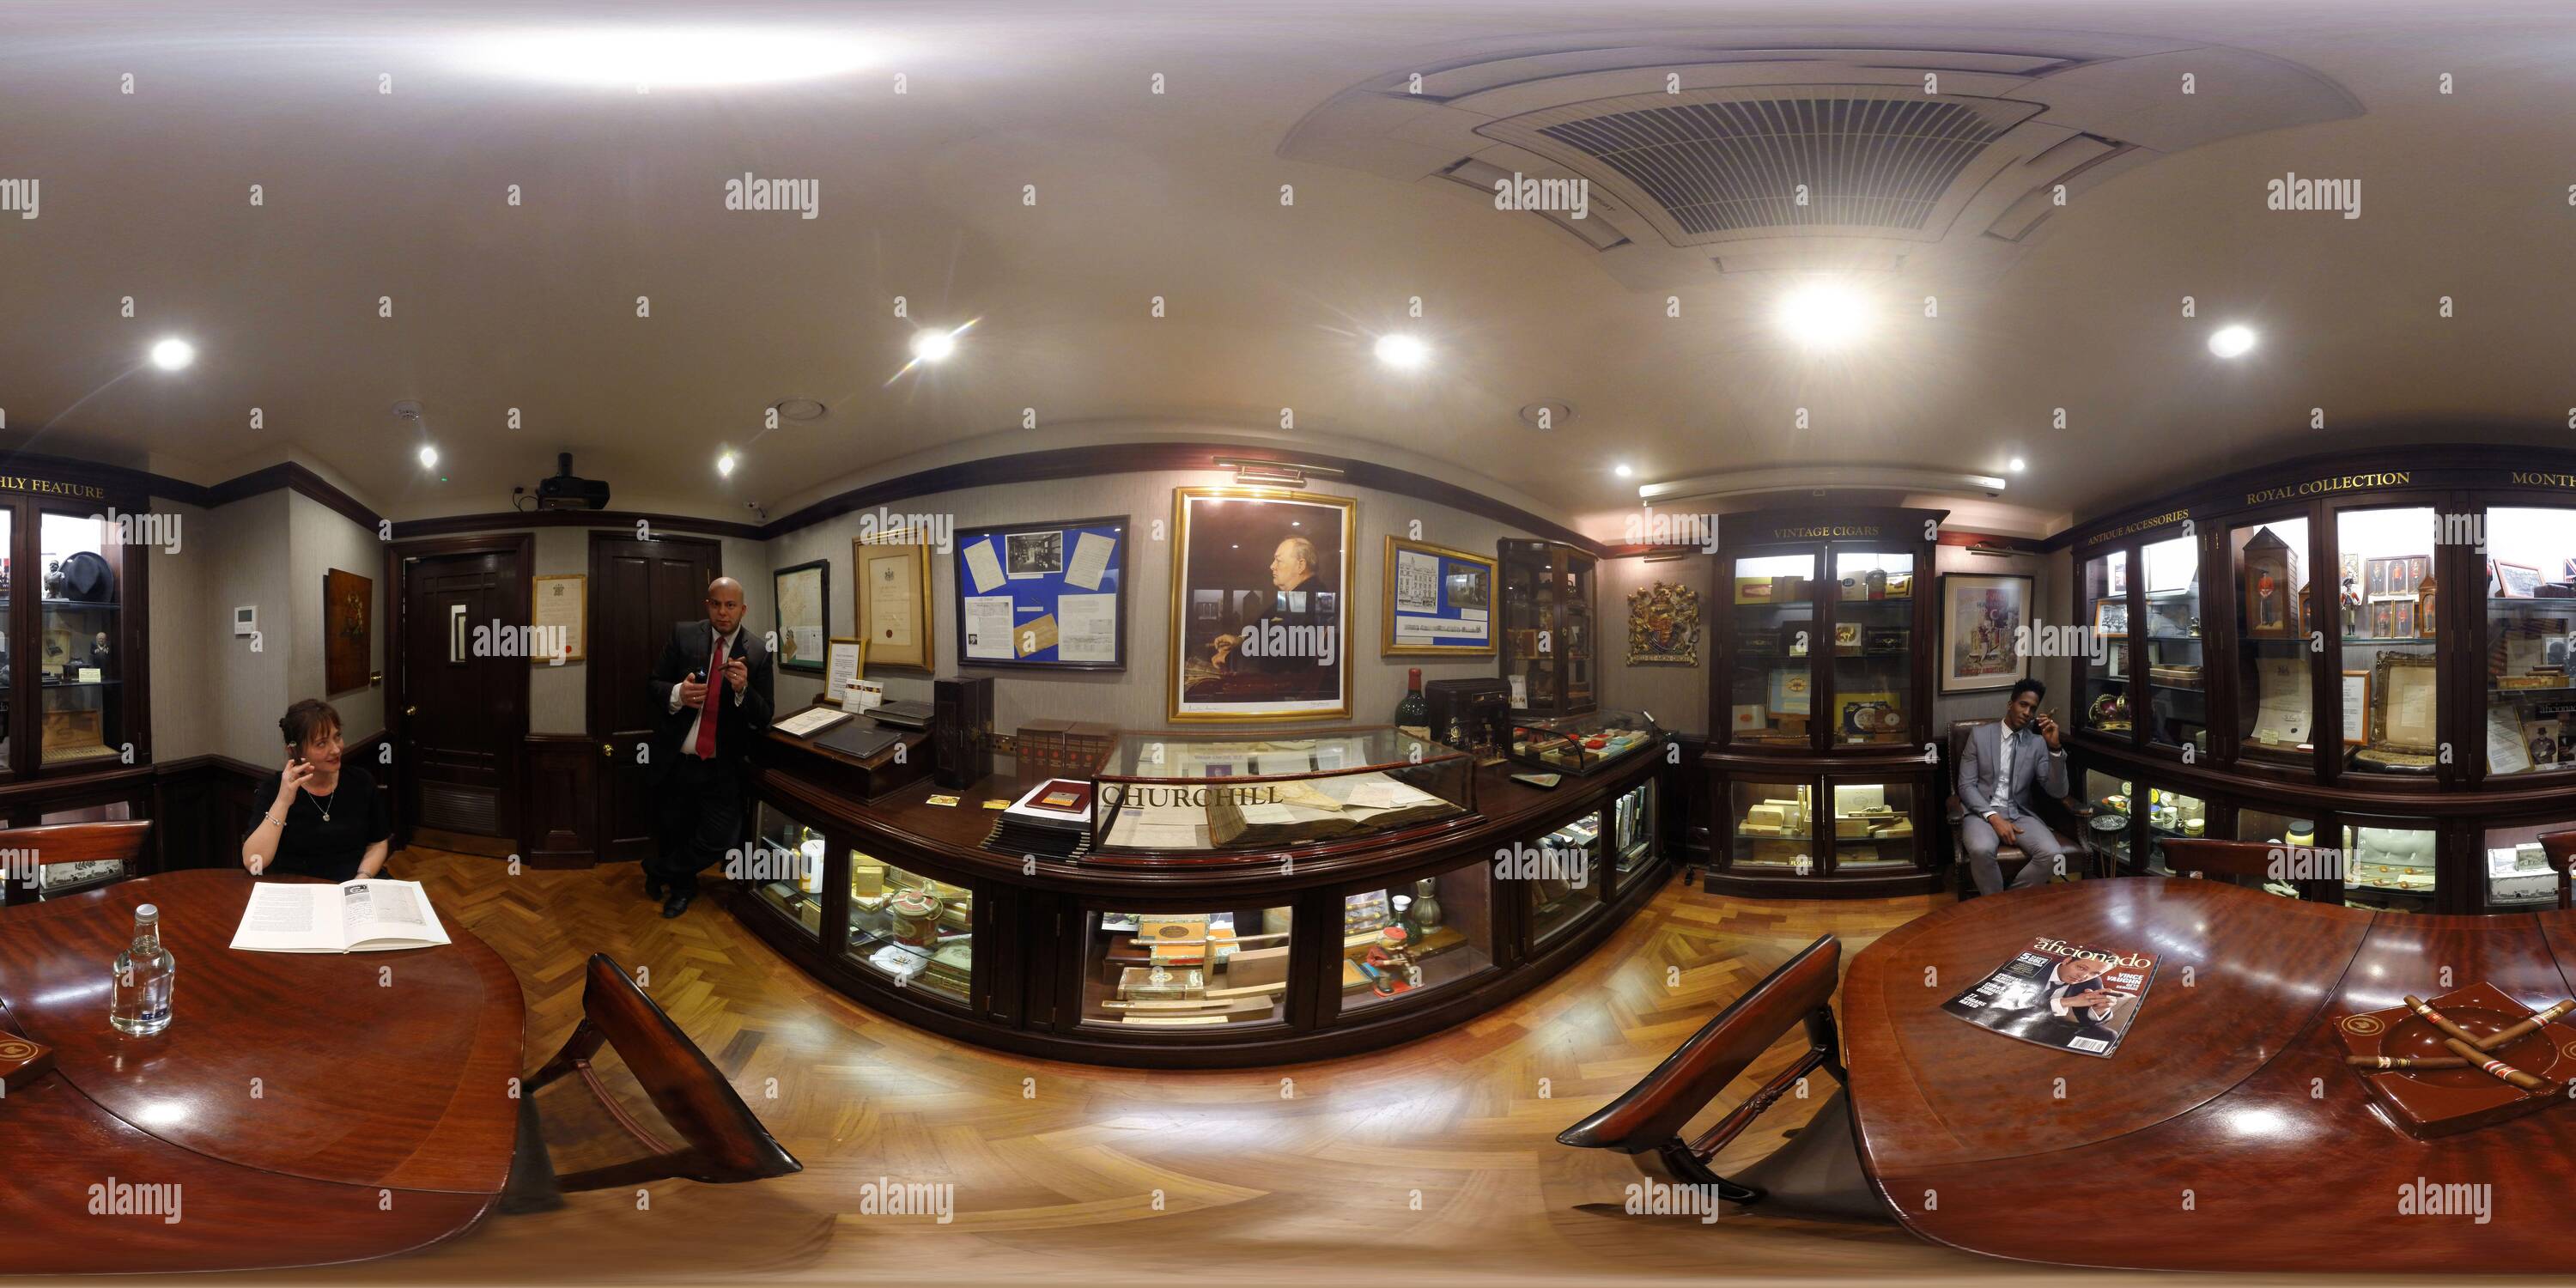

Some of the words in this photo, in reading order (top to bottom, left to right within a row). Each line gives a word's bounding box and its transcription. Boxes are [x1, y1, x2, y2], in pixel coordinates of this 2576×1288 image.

[32, 479, 104, 499] FEATURE
[2247, 486, 2295, 505] ROYAL
[2300, 471, 2411, 495] COLLECTION
[1772, 526, 1831, 538] VINTAGE
[1833, 526, 1879, 537] CIGARS
[2087, 527, 2123, 545] ANTIQUE
[2125, 508, 2189, 535] ACCESSORIES
[1102, 786, 1284, 808] CHURCHILL
[2033, 940, 2151, 968] aficionado
[2106, 975, 2142, 985] VAUGHN
[2118, 972, 2144, 981] VINCE
[1959, 999, 1978, 1008] RATED
[1963, 996, 1987, 1006] CIGARS
